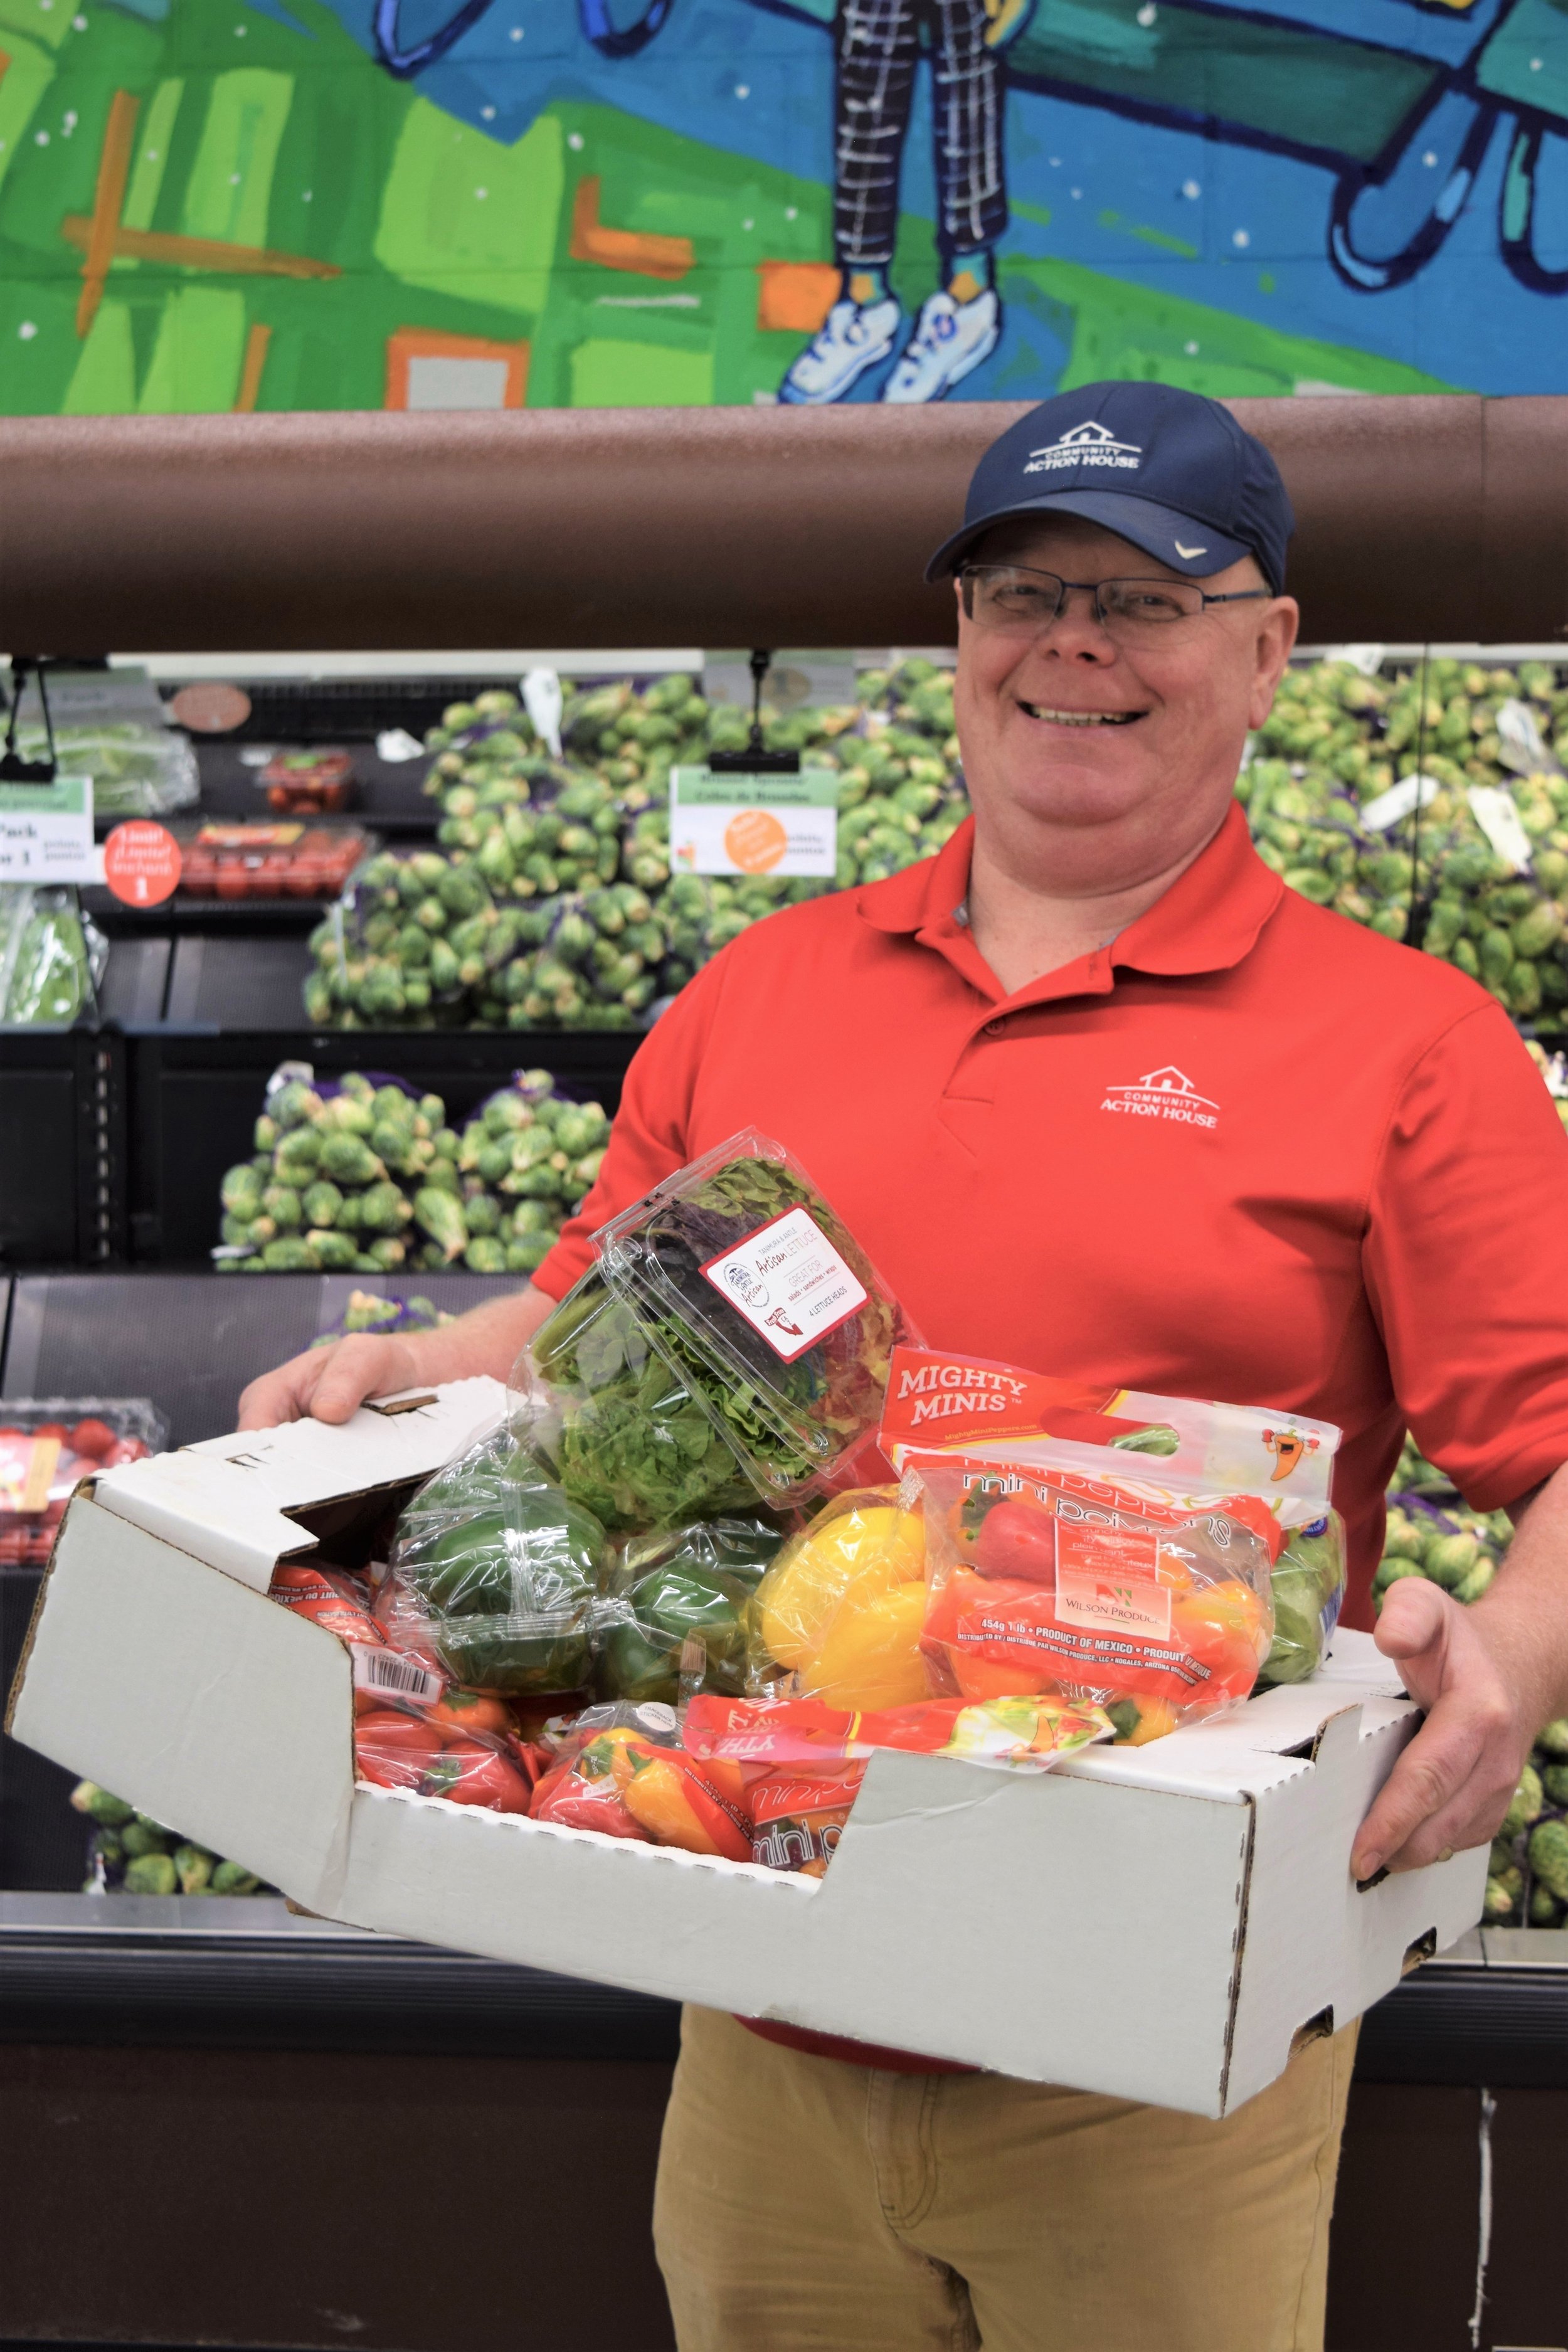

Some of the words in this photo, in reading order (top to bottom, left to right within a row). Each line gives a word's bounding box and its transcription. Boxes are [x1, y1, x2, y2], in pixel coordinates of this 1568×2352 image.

[1023, 455, 1080, 474] ACTION
[1082, 455, 1139, 469] HOUSE
[1045, 446, 1121, 460] COMMUNITY
[1100, 1098, 1160, 1117] ACTION
[1162, 1106, 1218, 1129] HOUSE
[1124, 1091, 1200, 1111] COMMUNITY
[755, 1252, 787, 1276] Artisan
[783, 1229, 818, 1257] LETTUCE
[758, 1237, 780, 1255] TANIMURA
[783, 1227, 798, 1239] ANTLE
[788, 1268, 809, 1288] GREAT
[807, 1259, 823, 1275] FOR
[788, 1290, 802, 1301] salads
[803, 1274, 824, 1291] sandwiches
[825, 1264, 837, 1276] wraps
[741, 1284, 764, 1308] Artisan
[812, 1297, 834, 1315] LETTUCE
[832, 1286, 847, 1301] HEADS
[897, 1365, 1028, 1399] MIGHTY
[910, 1392, 1007, 1426] MINIS
[945, 1424, 1037, 1441] MightyMiniPeppers.com
[963, 1472, 1048, 1505] mini
[1066, 1598, 1108, 1614] WILSON
[1111, 1607, 1160, 1624] PRODUCE
[957, 1633, 993, 1641] DISTRIBUTED
[1037, 1641, 1049, 1650] PAR
[1049, 1644, 1069, 1656] WILSON
[1069, 1650, 1098, 1662] PRODUCE,
[1098, 1655, 1110, 1663] LLC
[1115, 1657, 1143, 1667] NOGALES,
[1145, 1661, 1170, 1671] ARIZONA
[981, 1618, 1005, 1632] 454g
[1007, 1621, 1014, 1631] 1
[1016, 1623, 1026, 1633] lb
[1035, 1626, 1078, 1646] PRODUCT
[1079, 1637, 1093, 1648] OF
[1094, 1639, 1134, 1655] MEXICO
[1143, 1646, 1185, 1663] PRODUIT
[640, 1711, 660, 1720] STICKER
[645, 1705, 672, 1723] TRACEBACK
[684, 1766, 712, 1796] DISTRIBUTED
